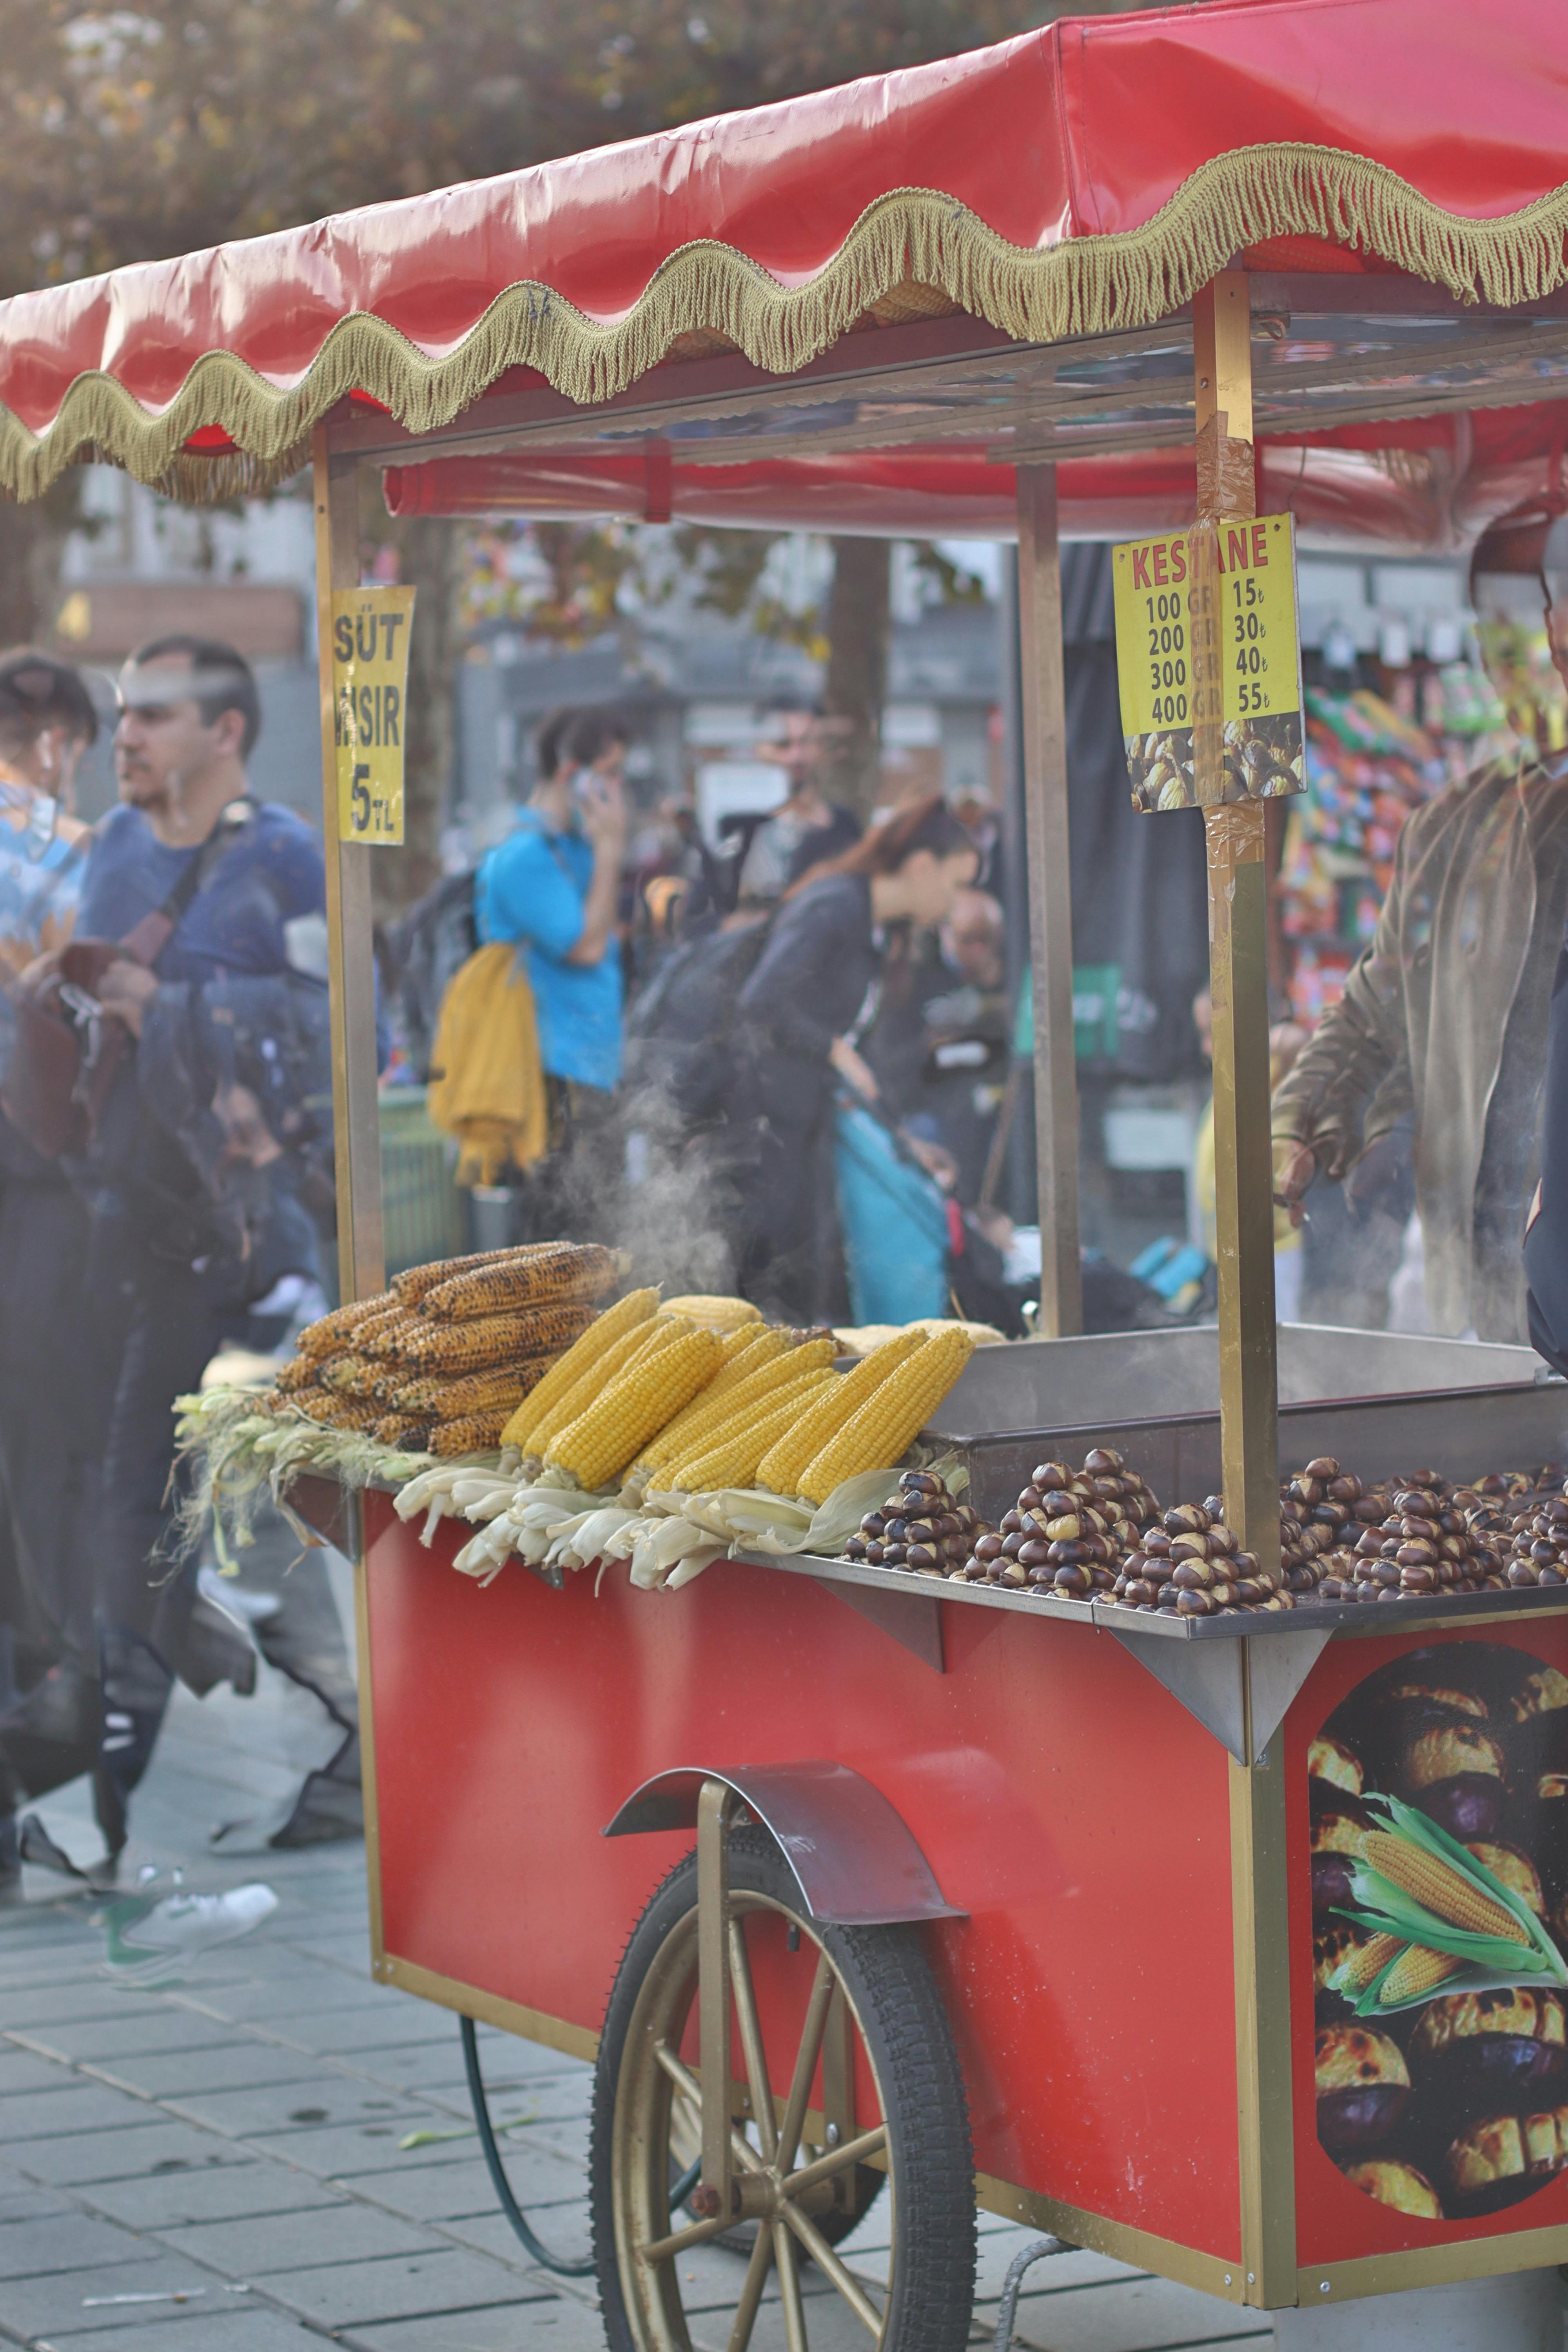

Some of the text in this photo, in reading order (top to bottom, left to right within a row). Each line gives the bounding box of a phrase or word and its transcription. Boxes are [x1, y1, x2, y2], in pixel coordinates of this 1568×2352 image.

[1132, 524, 1268, 590] KESTANE
[1146, 592, 1181, 623] 100
[334, 603, 404, 662] SÜT
[1149, 624, 1184, 656] 200
[1151, 659, 1186, 690] 300
[1152, 693, 1187, 724] 400
